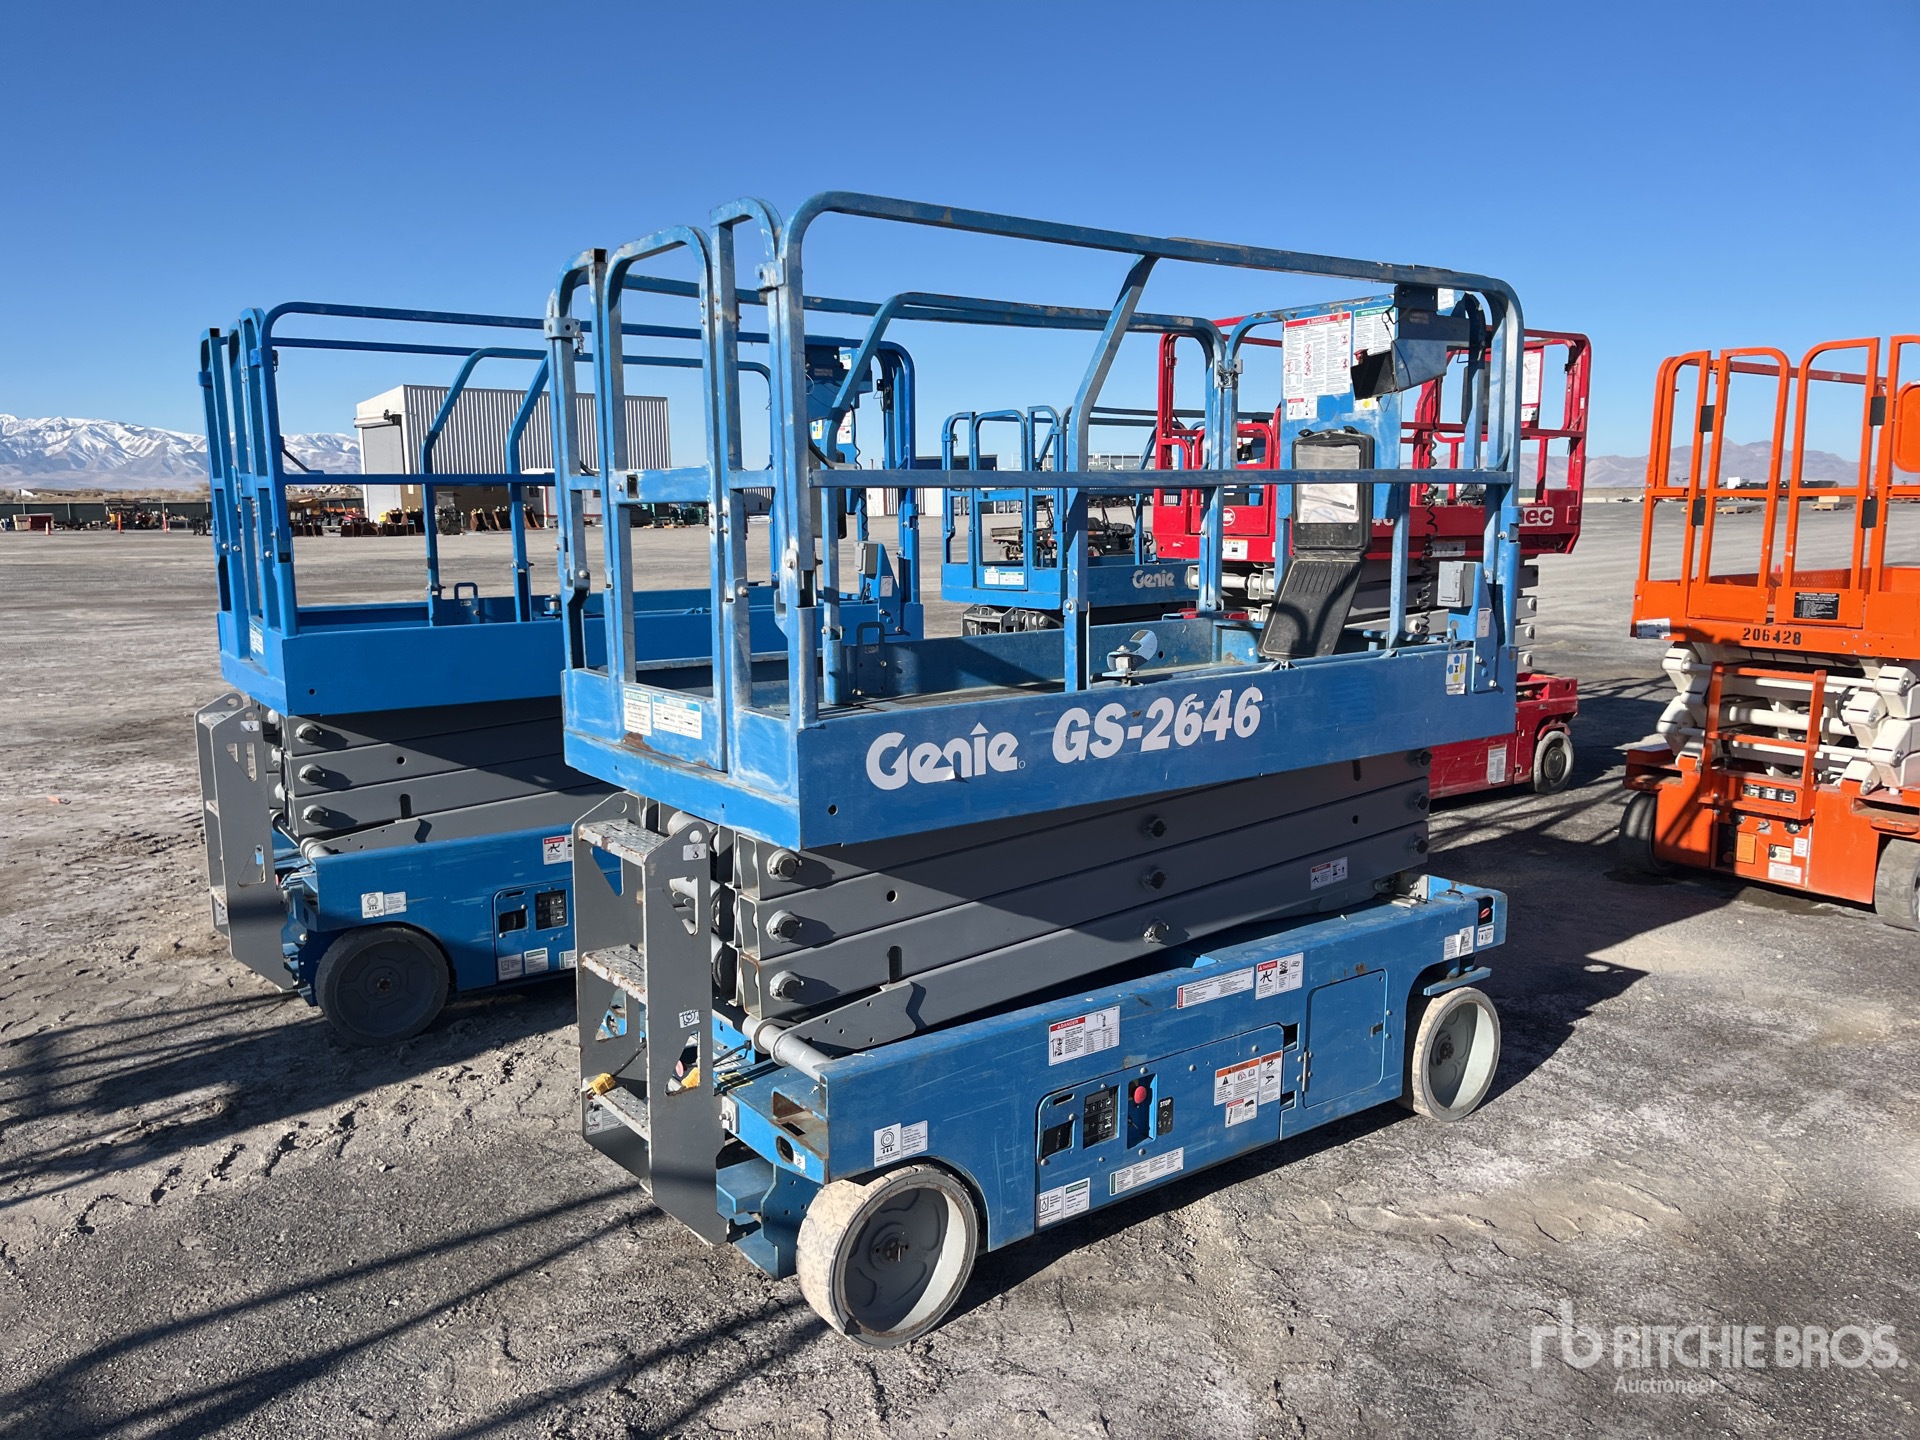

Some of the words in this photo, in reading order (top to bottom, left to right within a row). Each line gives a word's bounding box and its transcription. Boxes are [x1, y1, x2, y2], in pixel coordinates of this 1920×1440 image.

[1311, 316, 1331, 324] DANGER
[1521, 509, 1553, 524] ec
[1132, 569, 1175, 589] Genie
[1742, 627, 1802, 646] 206428
[866, 722, 1020, 791] Genie
[1052, 686, 1263, 765] GS-2646
[1060, 1019, 1079, 1029] DANGER
[1160, 1099, 1172, 1107] STOP
